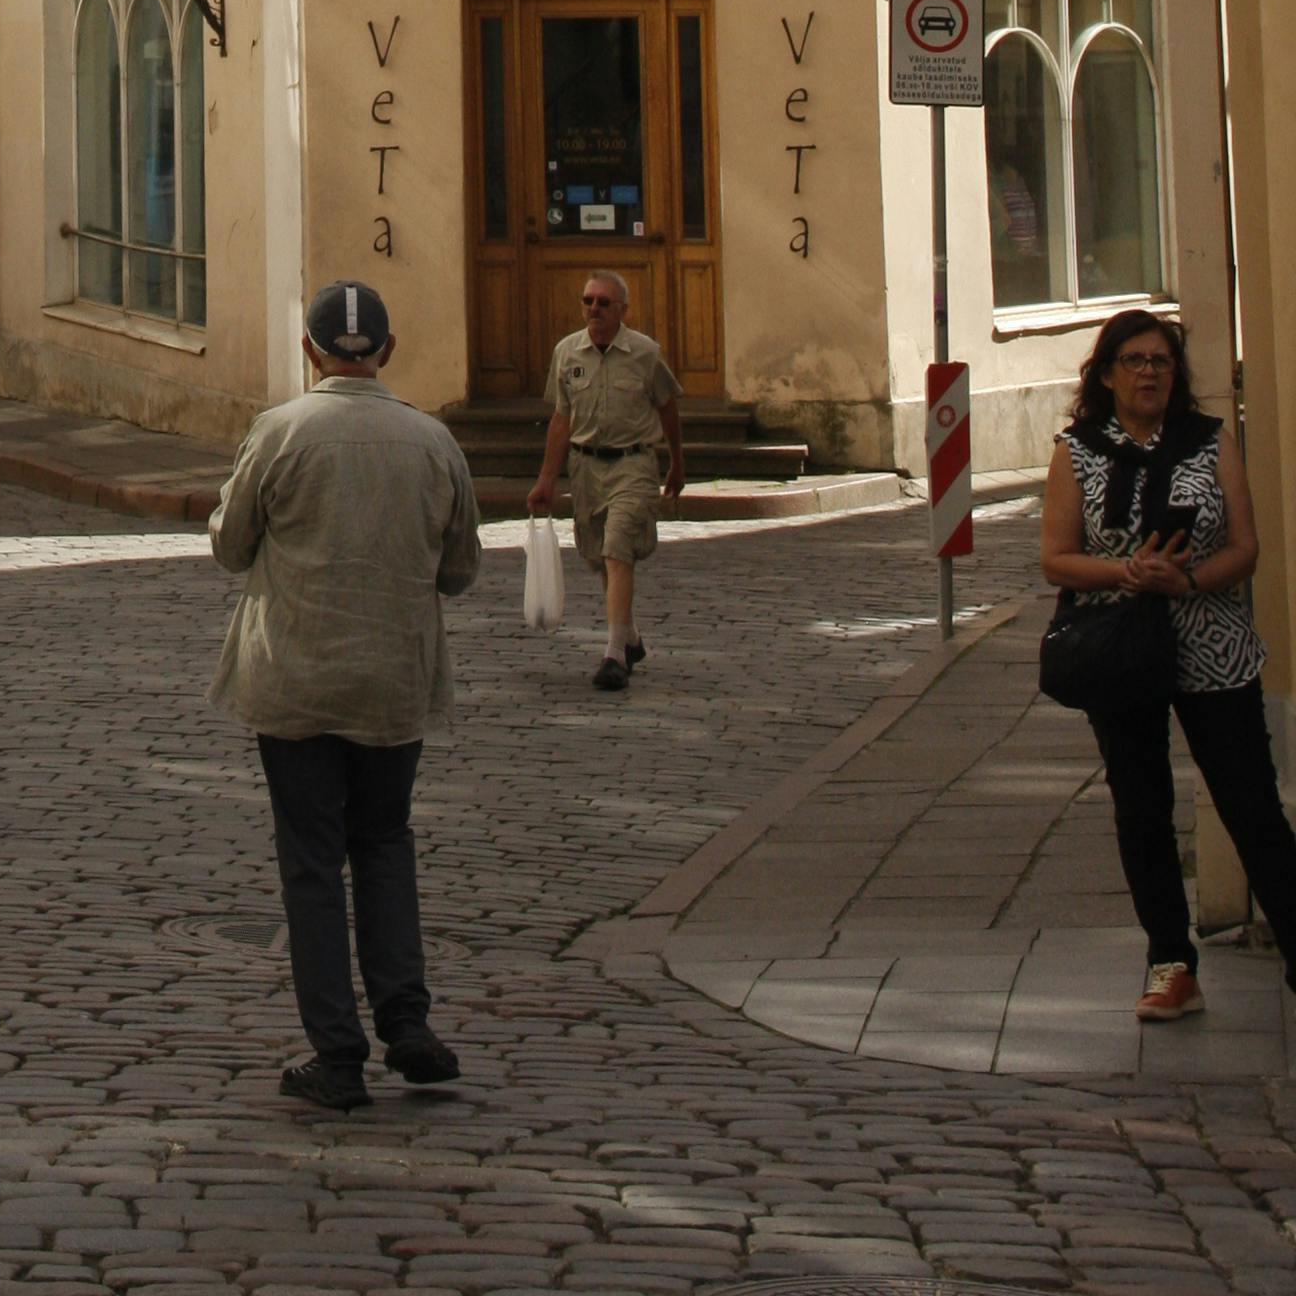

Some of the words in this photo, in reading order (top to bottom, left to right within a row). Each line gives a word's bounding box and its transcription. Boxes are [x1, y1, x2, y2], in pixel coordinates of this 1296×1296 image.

[908, 56, 930, 64] Välja
[933, 56, 966, 65] arvatud
[896, 73, 923, 81] kauba
[960, 83, 979, 91] KOV
